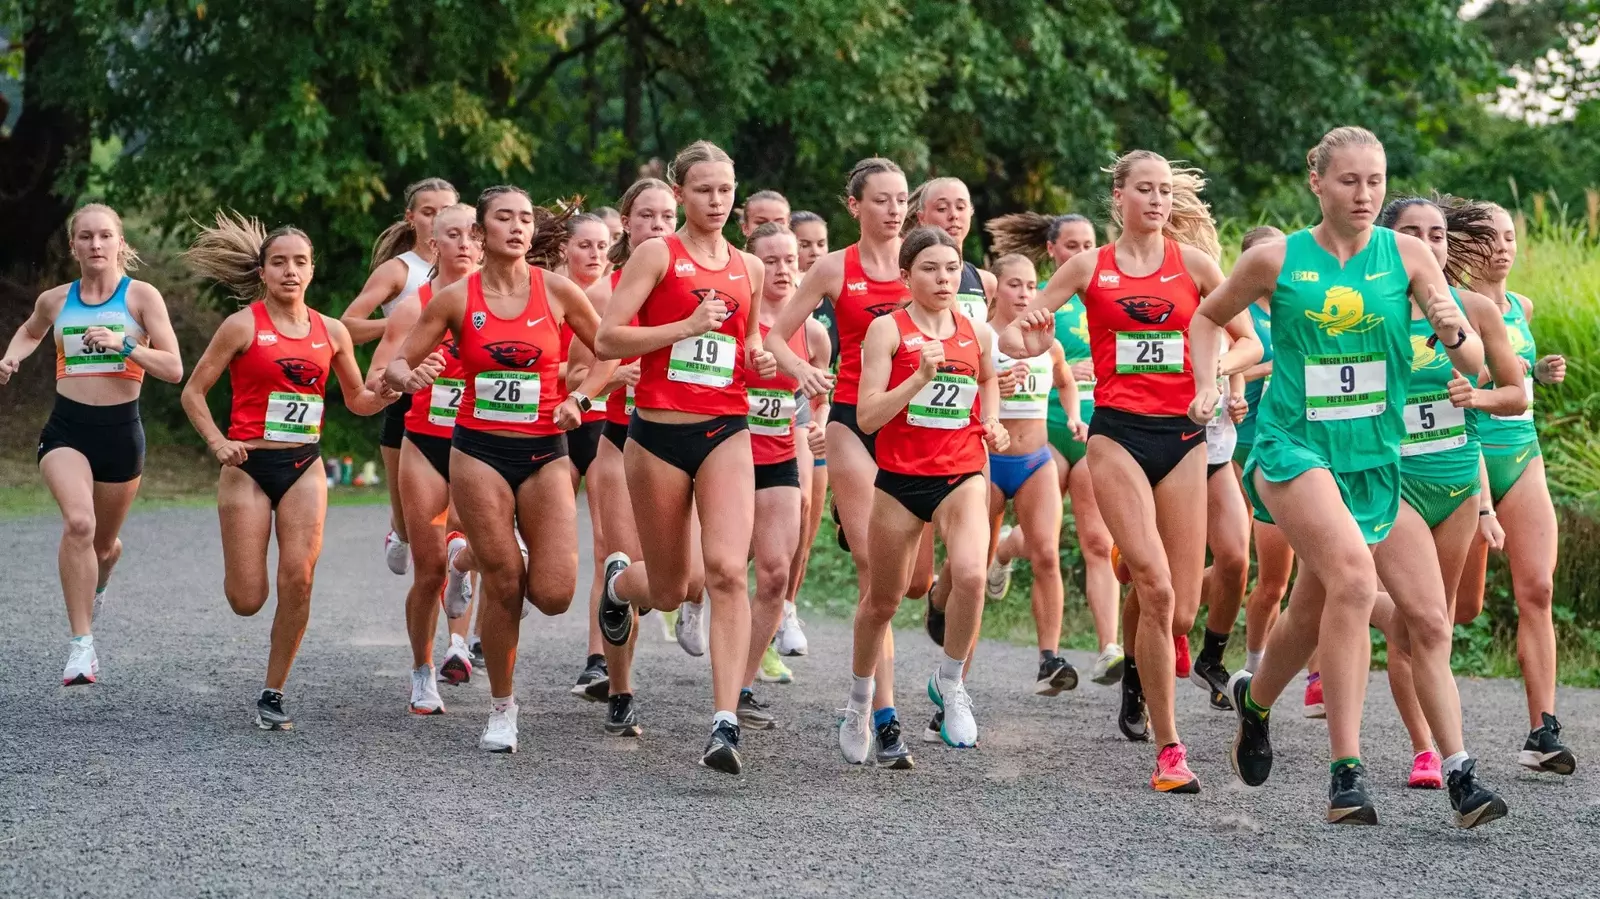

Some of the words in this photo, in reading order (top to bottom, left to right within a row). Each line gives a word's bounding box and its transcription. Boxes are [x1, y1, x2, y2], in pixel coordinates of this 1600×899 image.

[693, 339, 718, 364] 19
[1136, 341, 1164, 363] 25
[494, 380, 520, 402] 26
[1340, 366, 1355, 393] 9
[931, 383, 959, 407] 22
[284, 402, 309, 423] 27
[757, 398, 781, 418] 28
[1419, 404, 1435, 429] 5
